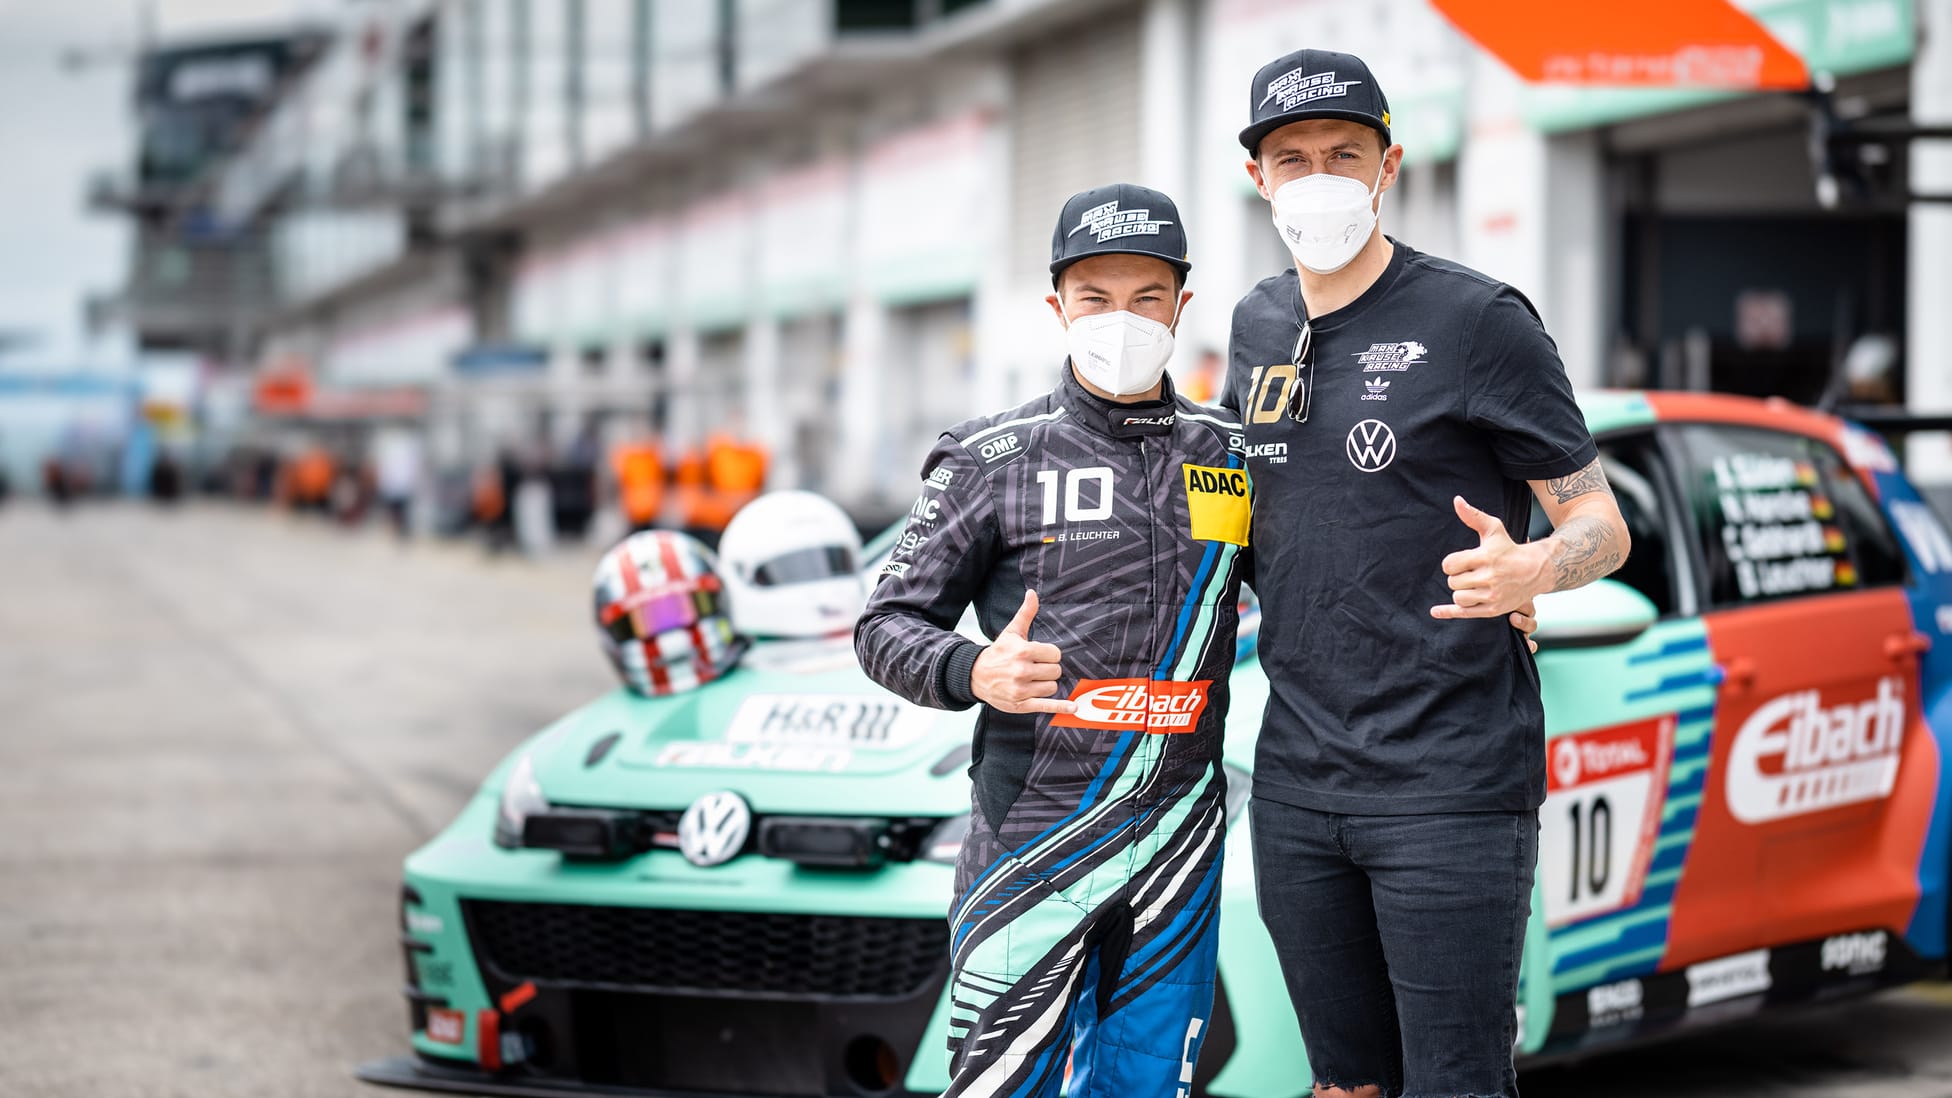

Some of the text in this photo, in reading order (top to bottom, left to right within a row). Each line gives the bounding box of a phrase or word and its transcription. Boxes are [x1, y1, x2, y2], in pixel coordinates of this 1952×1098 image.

[1268, 70, 1301, 96] MAX
[1286, 84, 1345, 108] RACING
[1082, 203, 1117, 225] MAX
[1369, 344, 1395, 353] MAX
[1366, 362, 1408, 371] RACING
[1245, 364, 1296, 426] 10
[1361, 392, 1388, 401] adidas
[1123, 414, 1175, 426] FALKE
[981, 435, 1018, 458] OMP
[1246, 443, 1288, 458] LKEN
[1189, 469, 1246, 497] ADAC
[1036, 467, 1114, 526] 10
[1070, 531, 1120, 541] LEUCHTER
[1073, 685, 1202, 724] Eibach
[761, 703, 849, 735] H&R
[1582, 738, 1648, 775] TOTAL
[1726, 676, 1905, 825] Eibach
[1569, 795, 1612, 905] 10
